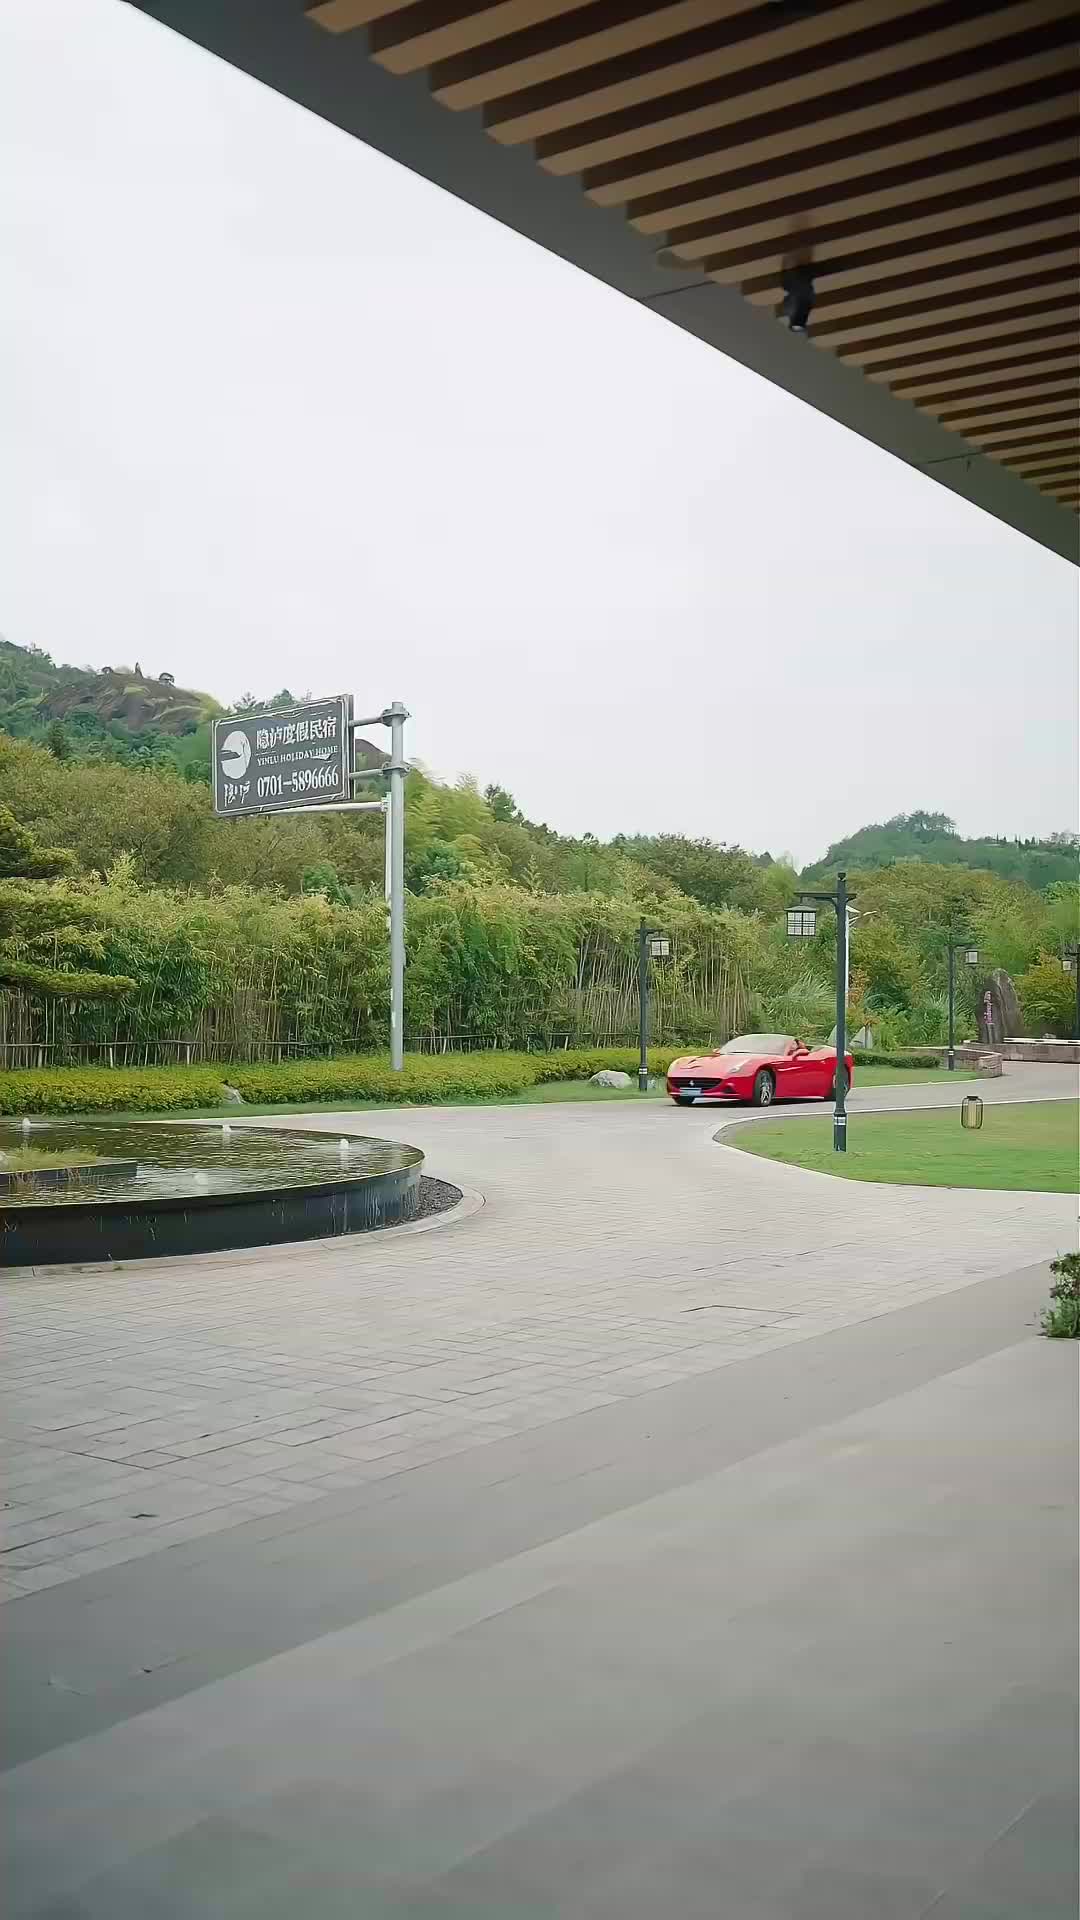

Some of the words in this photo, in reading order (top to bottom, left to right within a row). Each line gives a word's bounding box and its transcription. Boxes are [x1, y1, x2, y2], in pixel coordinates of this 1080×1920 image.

[257, 755, 279, 767] YINLU
[280, 749, 313, 763] HOLIDAY
[314, 745, 339, 757] HOME
[257, 764, 339, 798] 0701-5896666
